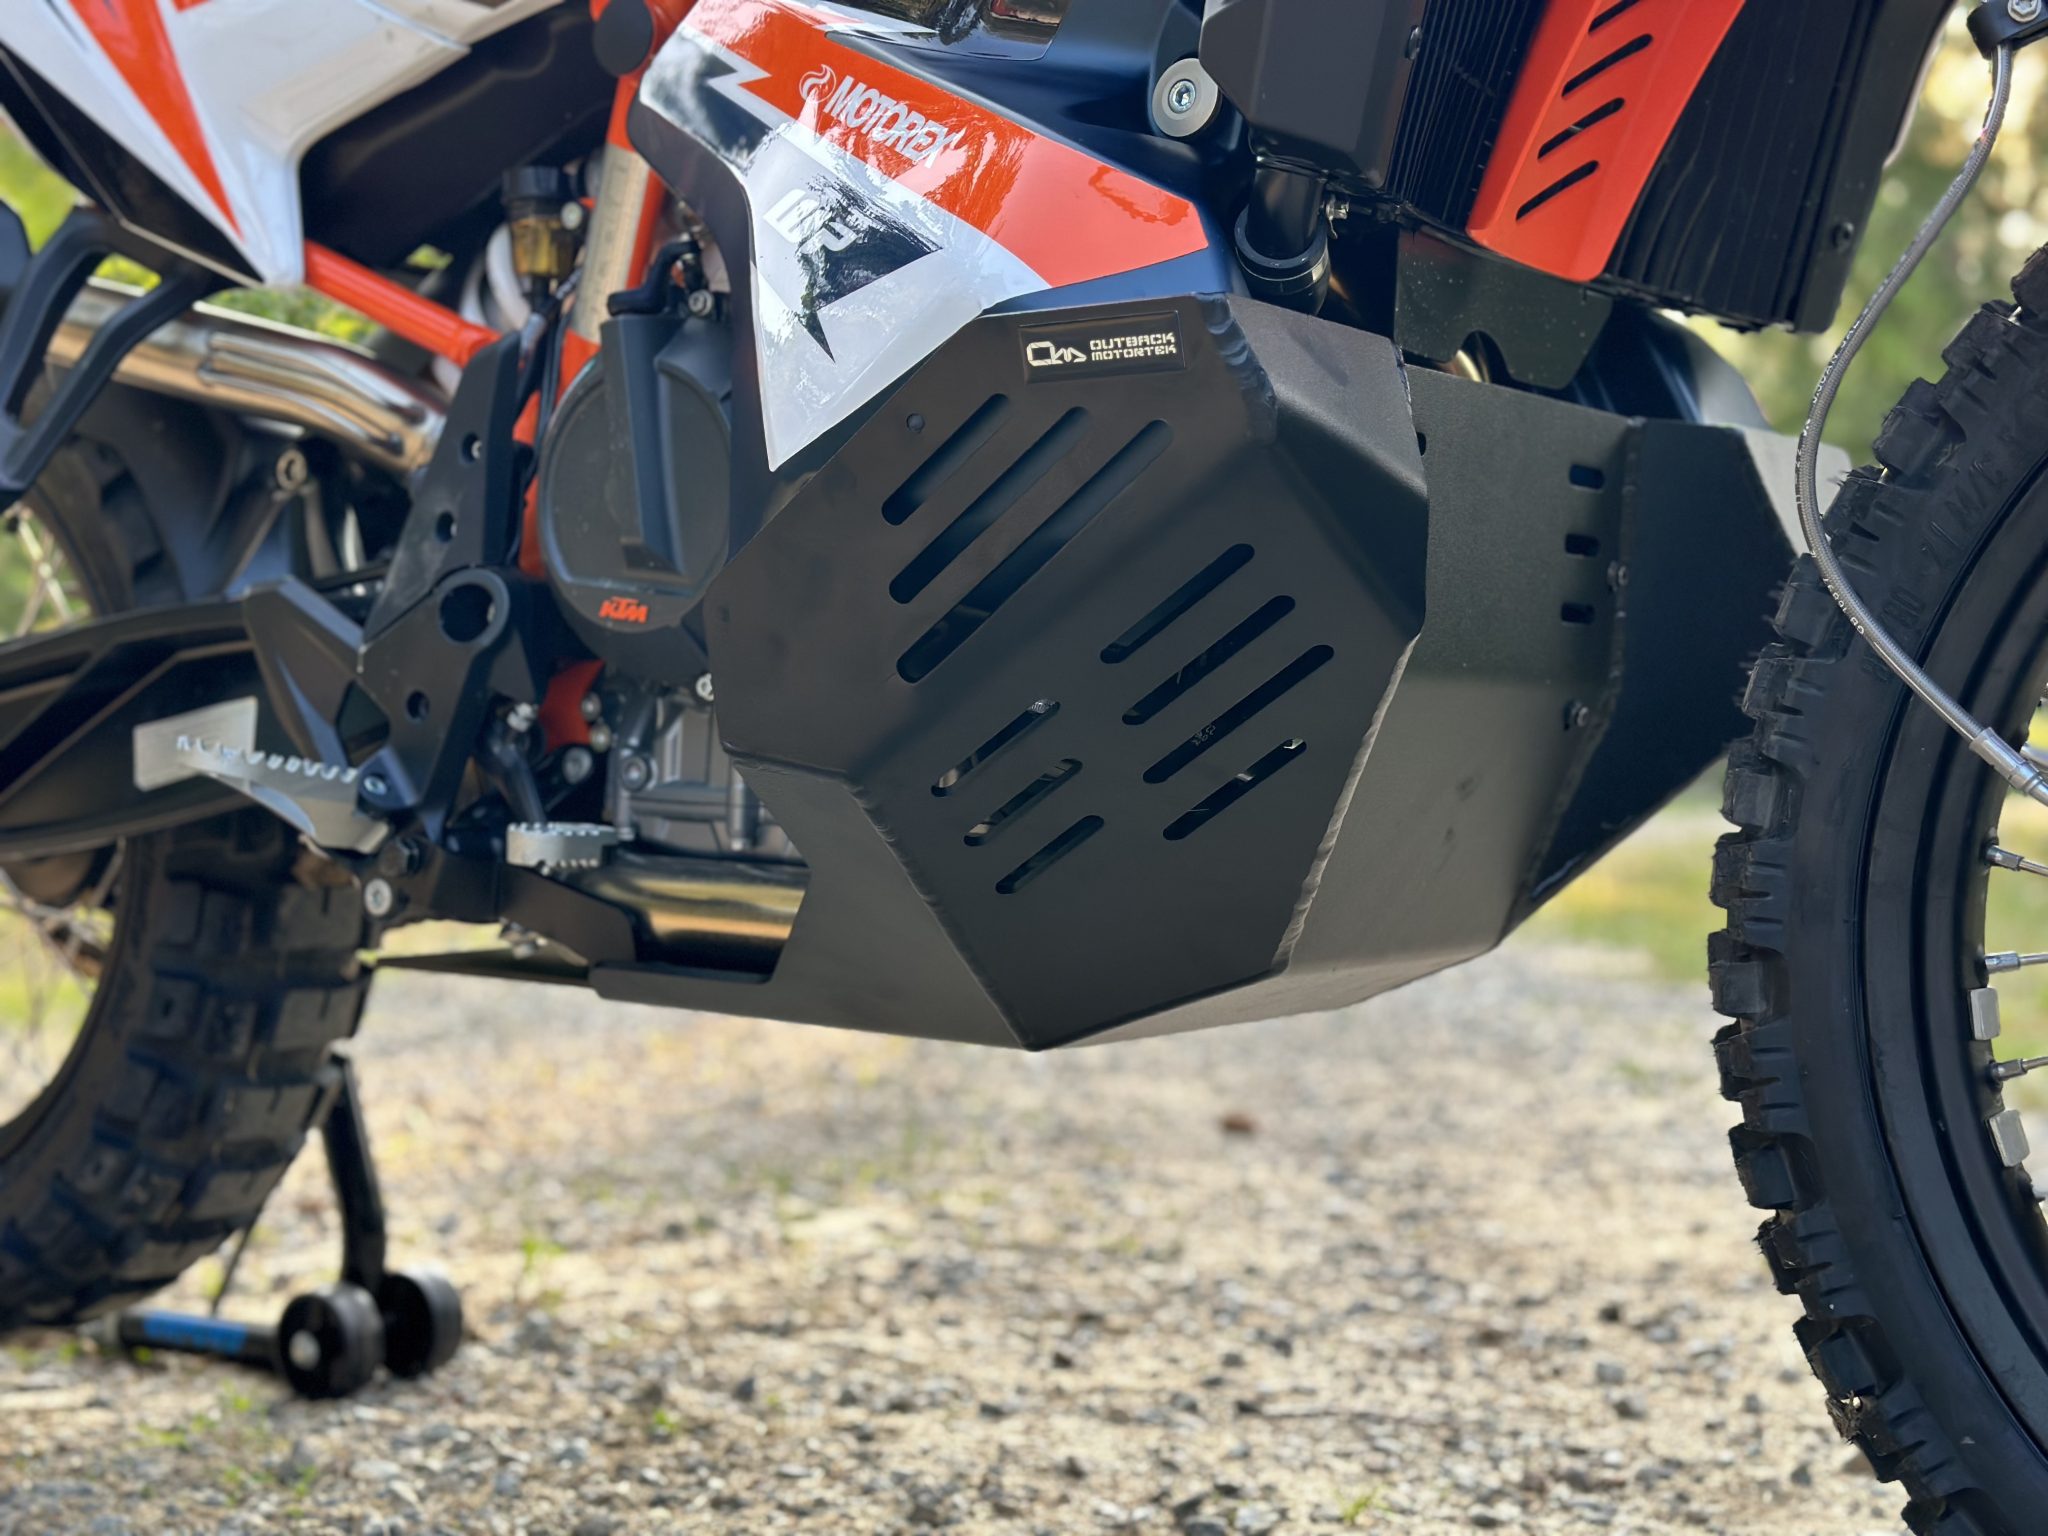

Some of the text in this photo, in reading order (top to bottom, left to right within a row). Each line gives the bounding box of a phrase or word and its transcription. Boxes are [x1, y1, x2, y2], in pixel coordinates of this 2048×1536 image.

[823, 75, 957, 169] MOTOREX
[1089, 332, 1176, 350] OUTBACK
[1091, 344, 1177, 361] MOTORTEK
[598, 596, 648, 624] KTM
